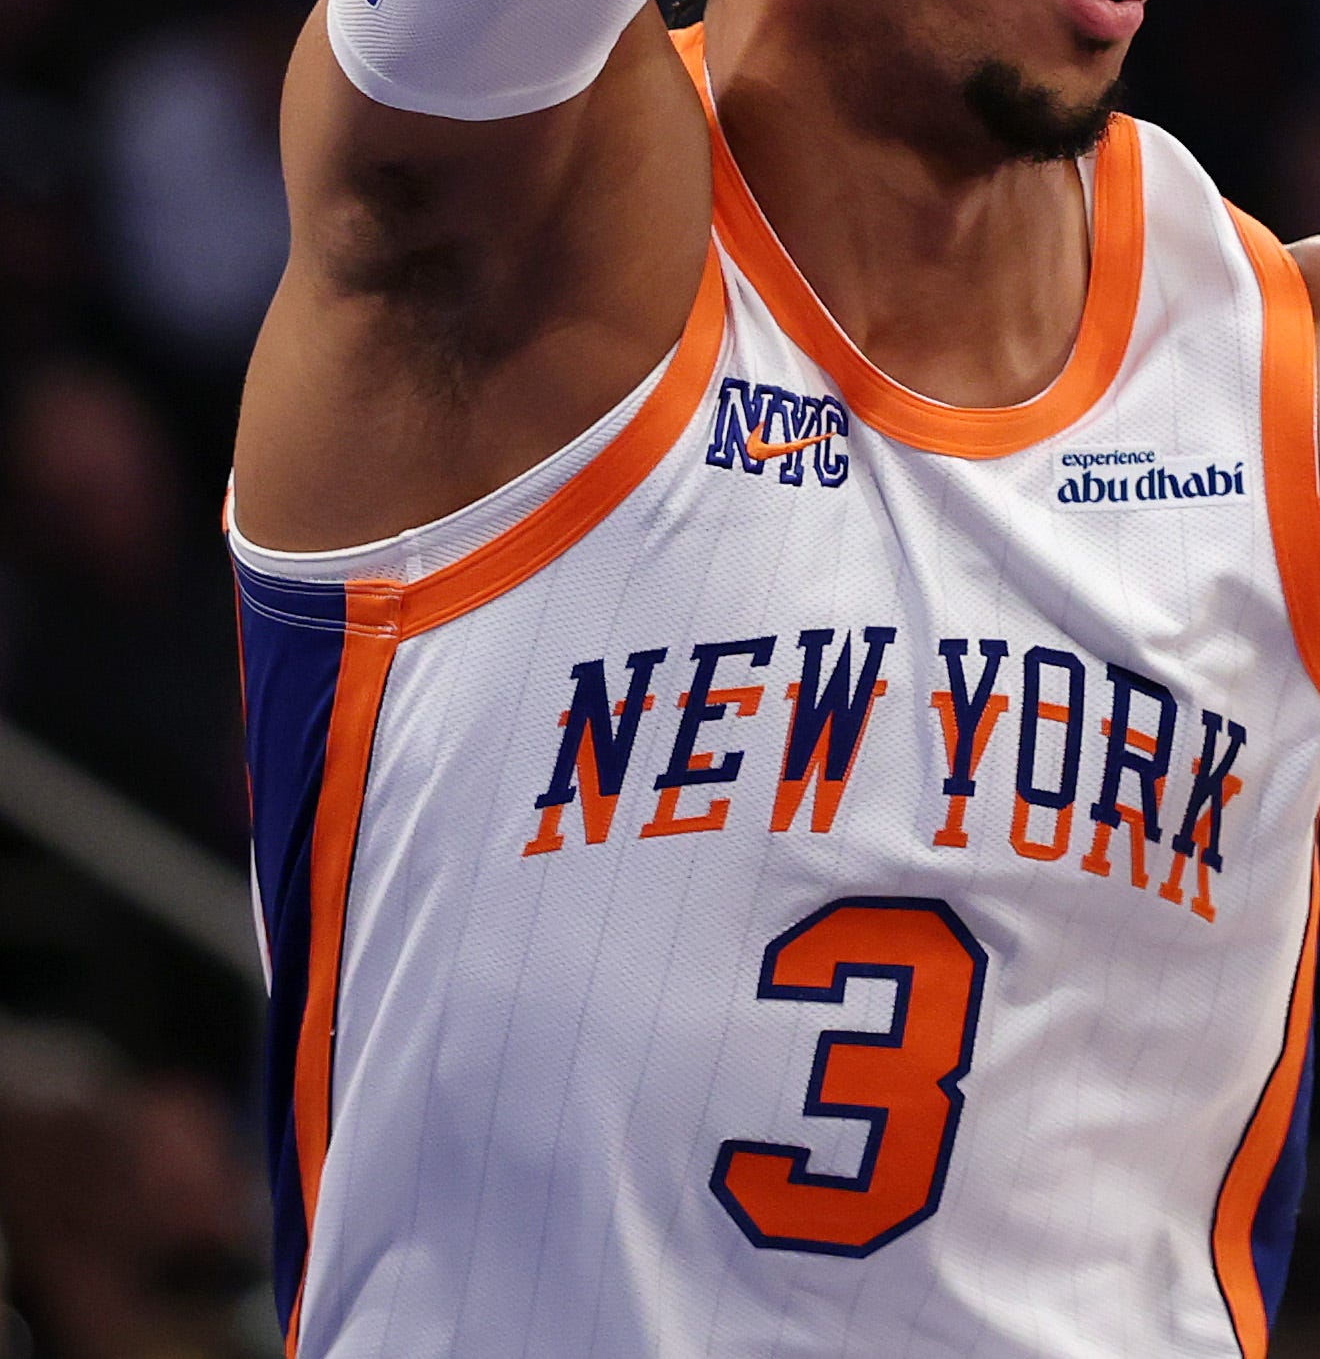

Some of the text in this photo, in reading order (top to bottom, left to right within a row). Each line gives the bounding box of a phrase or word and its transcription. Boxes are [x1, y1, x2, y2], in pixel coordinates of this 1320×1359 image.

[707, 377, 849, 488] NYC
[1057, 462, 1245, 504] abu dhabi
[1061, 449, 1156, 469] experience
[521, 625, 1248, 924] NEW YORK
[709, 896, 989, 1258] 3
